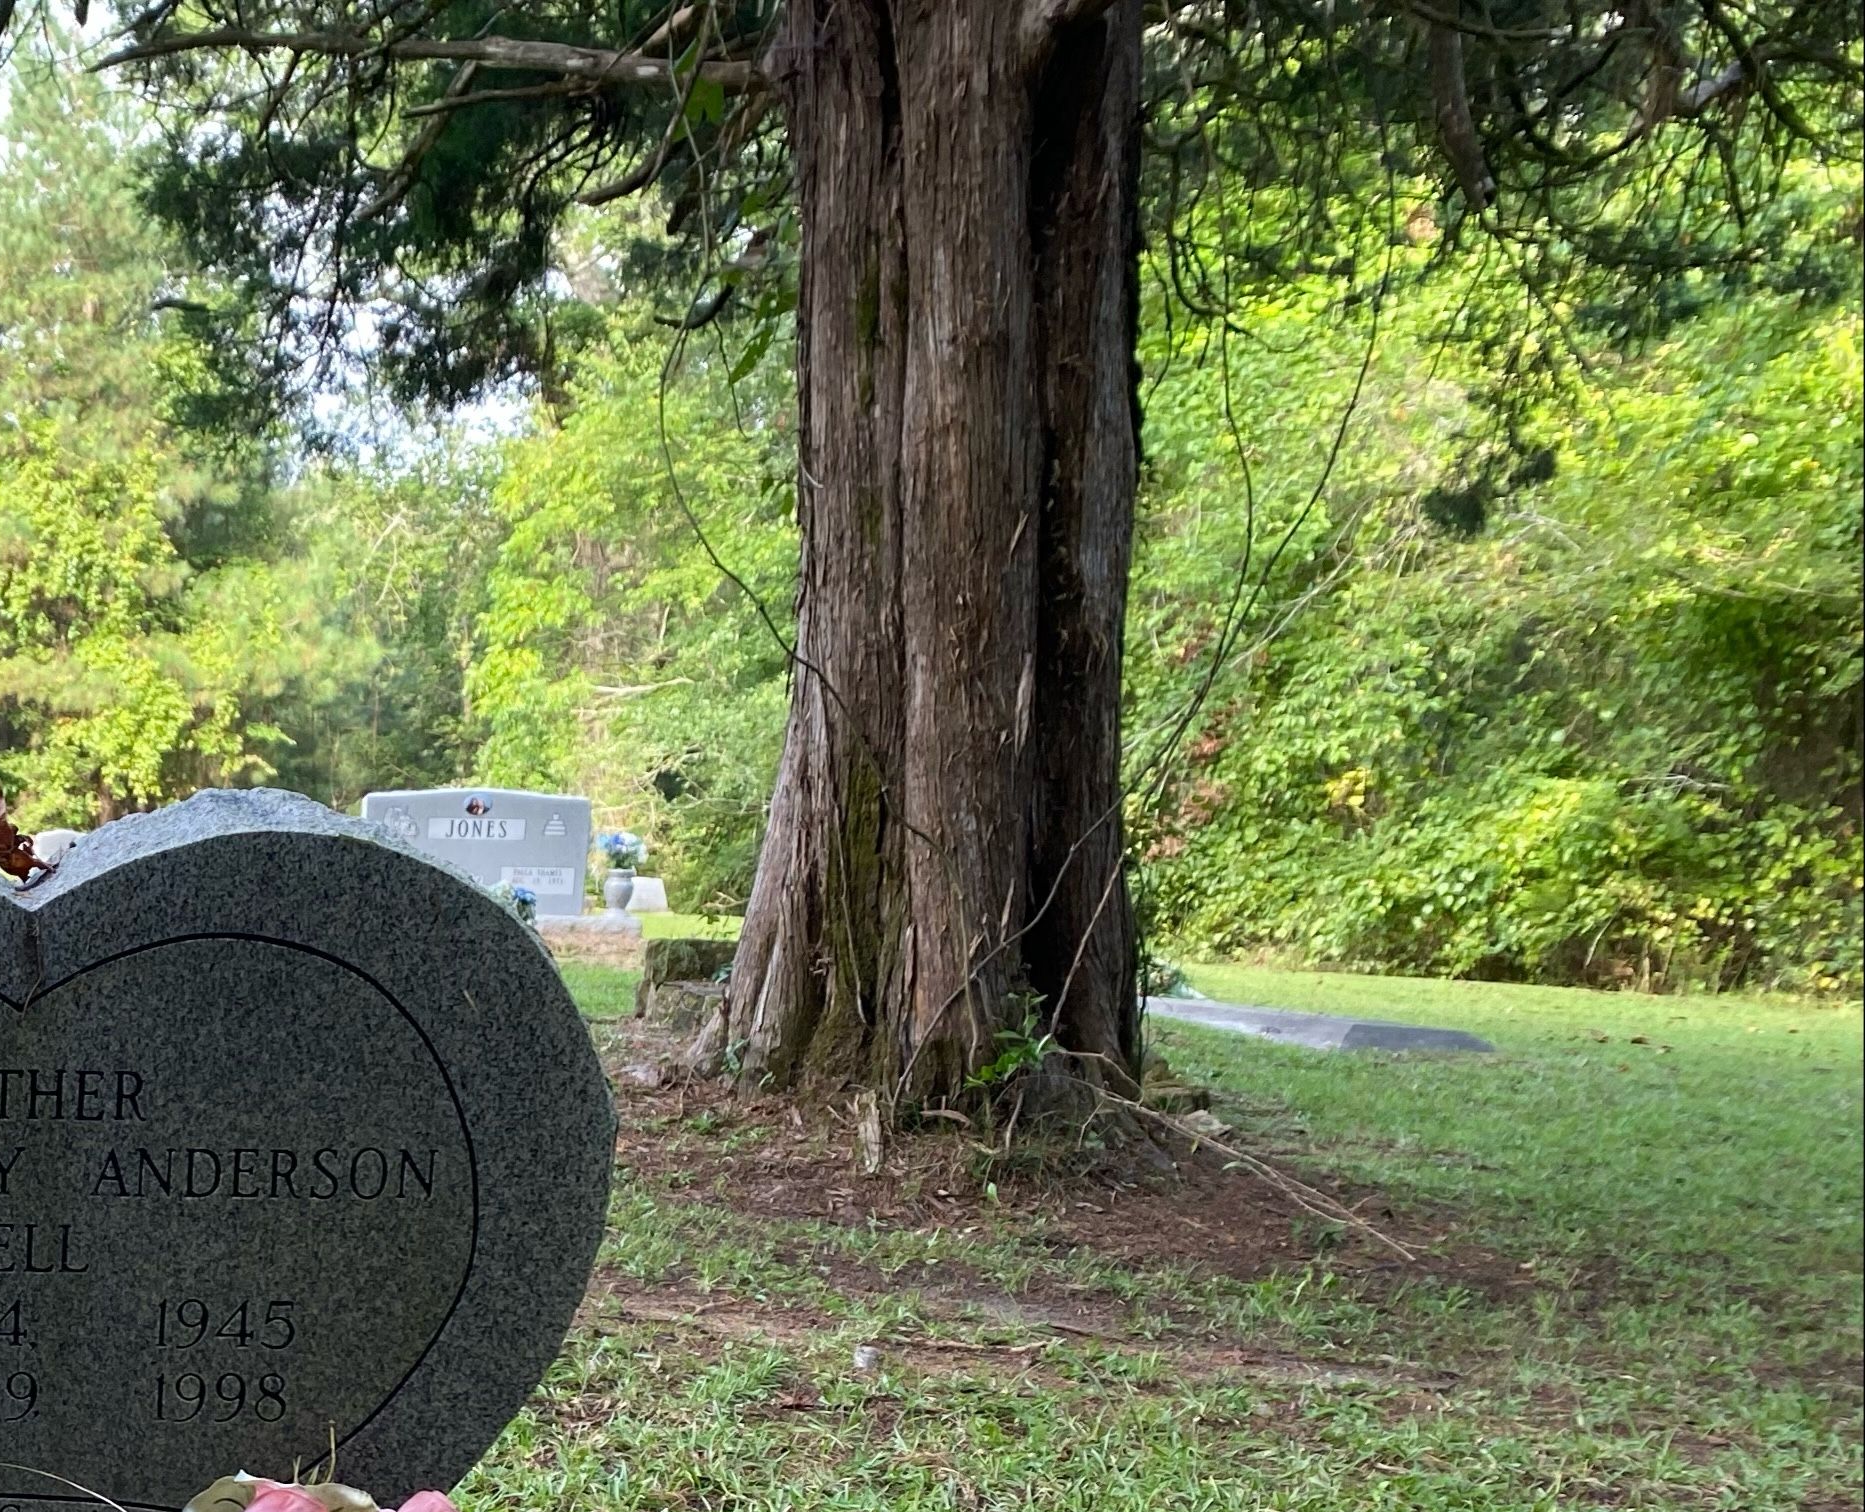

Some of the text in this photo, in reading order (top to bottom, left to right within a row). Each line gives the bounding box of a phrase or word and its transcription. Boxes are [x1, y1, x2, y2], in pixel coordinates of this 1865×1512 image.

[444, 818, 508, 838] JONES
[90, 1146, 439, 1200] ANDERSON
[155, 1298, 296, 1350] 1945
[154, 1372, 287, 1423] 1998
